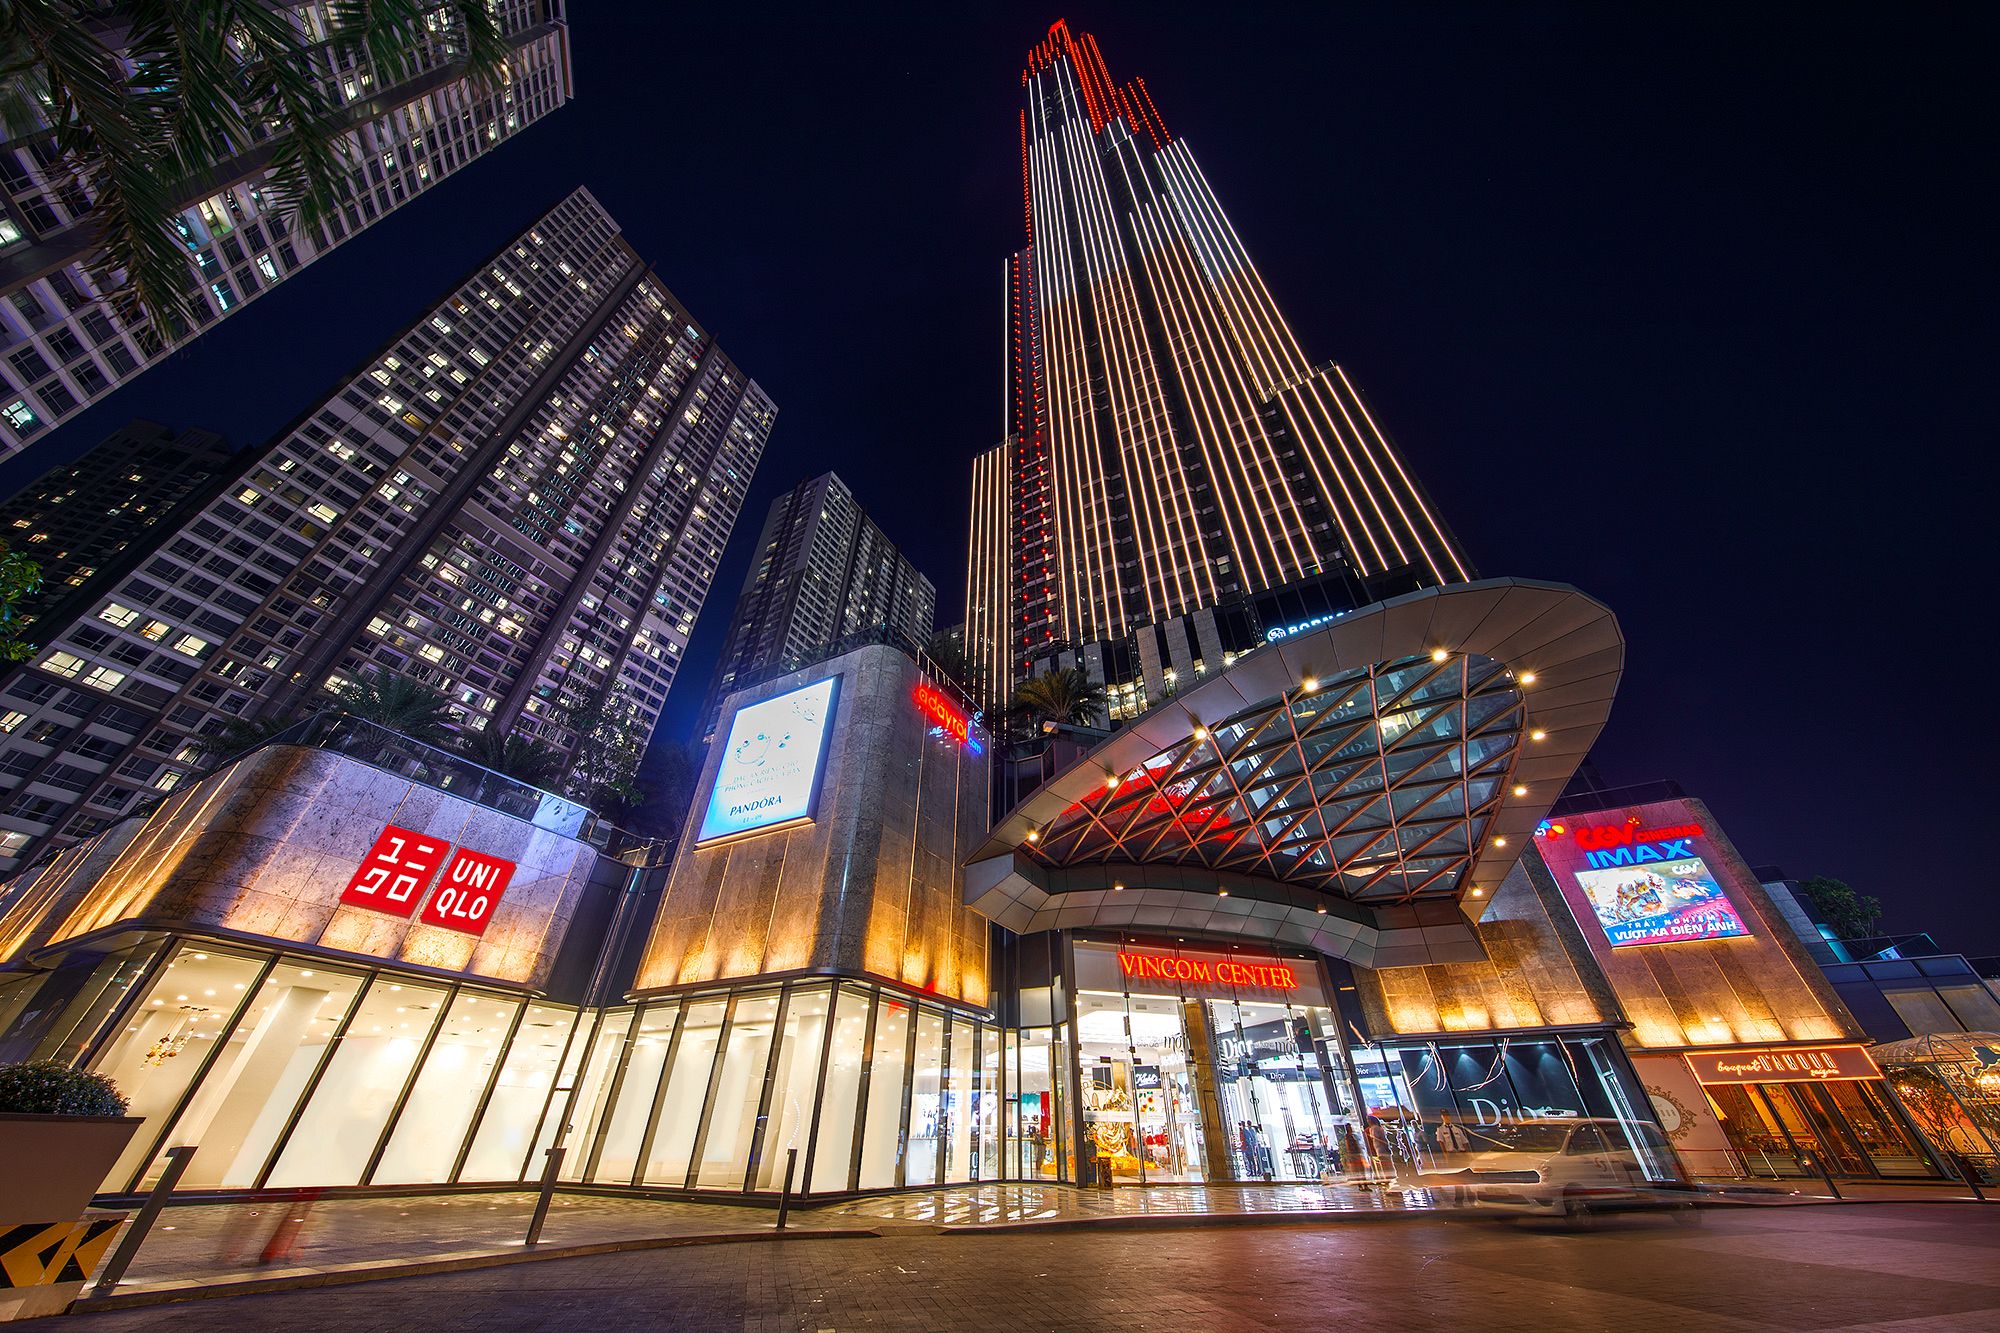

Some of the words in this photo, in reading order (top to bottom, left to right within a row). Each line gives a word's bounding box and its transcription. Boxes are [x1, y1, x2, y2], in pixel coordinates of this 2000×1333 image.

[729, 795, 782, 817] PANDORA
[1635, 823, 1703, 843] CINEMAS
[1585, 839, 1694, 869] IMAX
[452, 857, 501, 891] UNI
[435, 887, 489, 921] QLO
[1651, 927, 1671, 938] XA
[1119, 953, 1213, 983] VINCOM
[1216, 962, 1297, 989] CENTER
